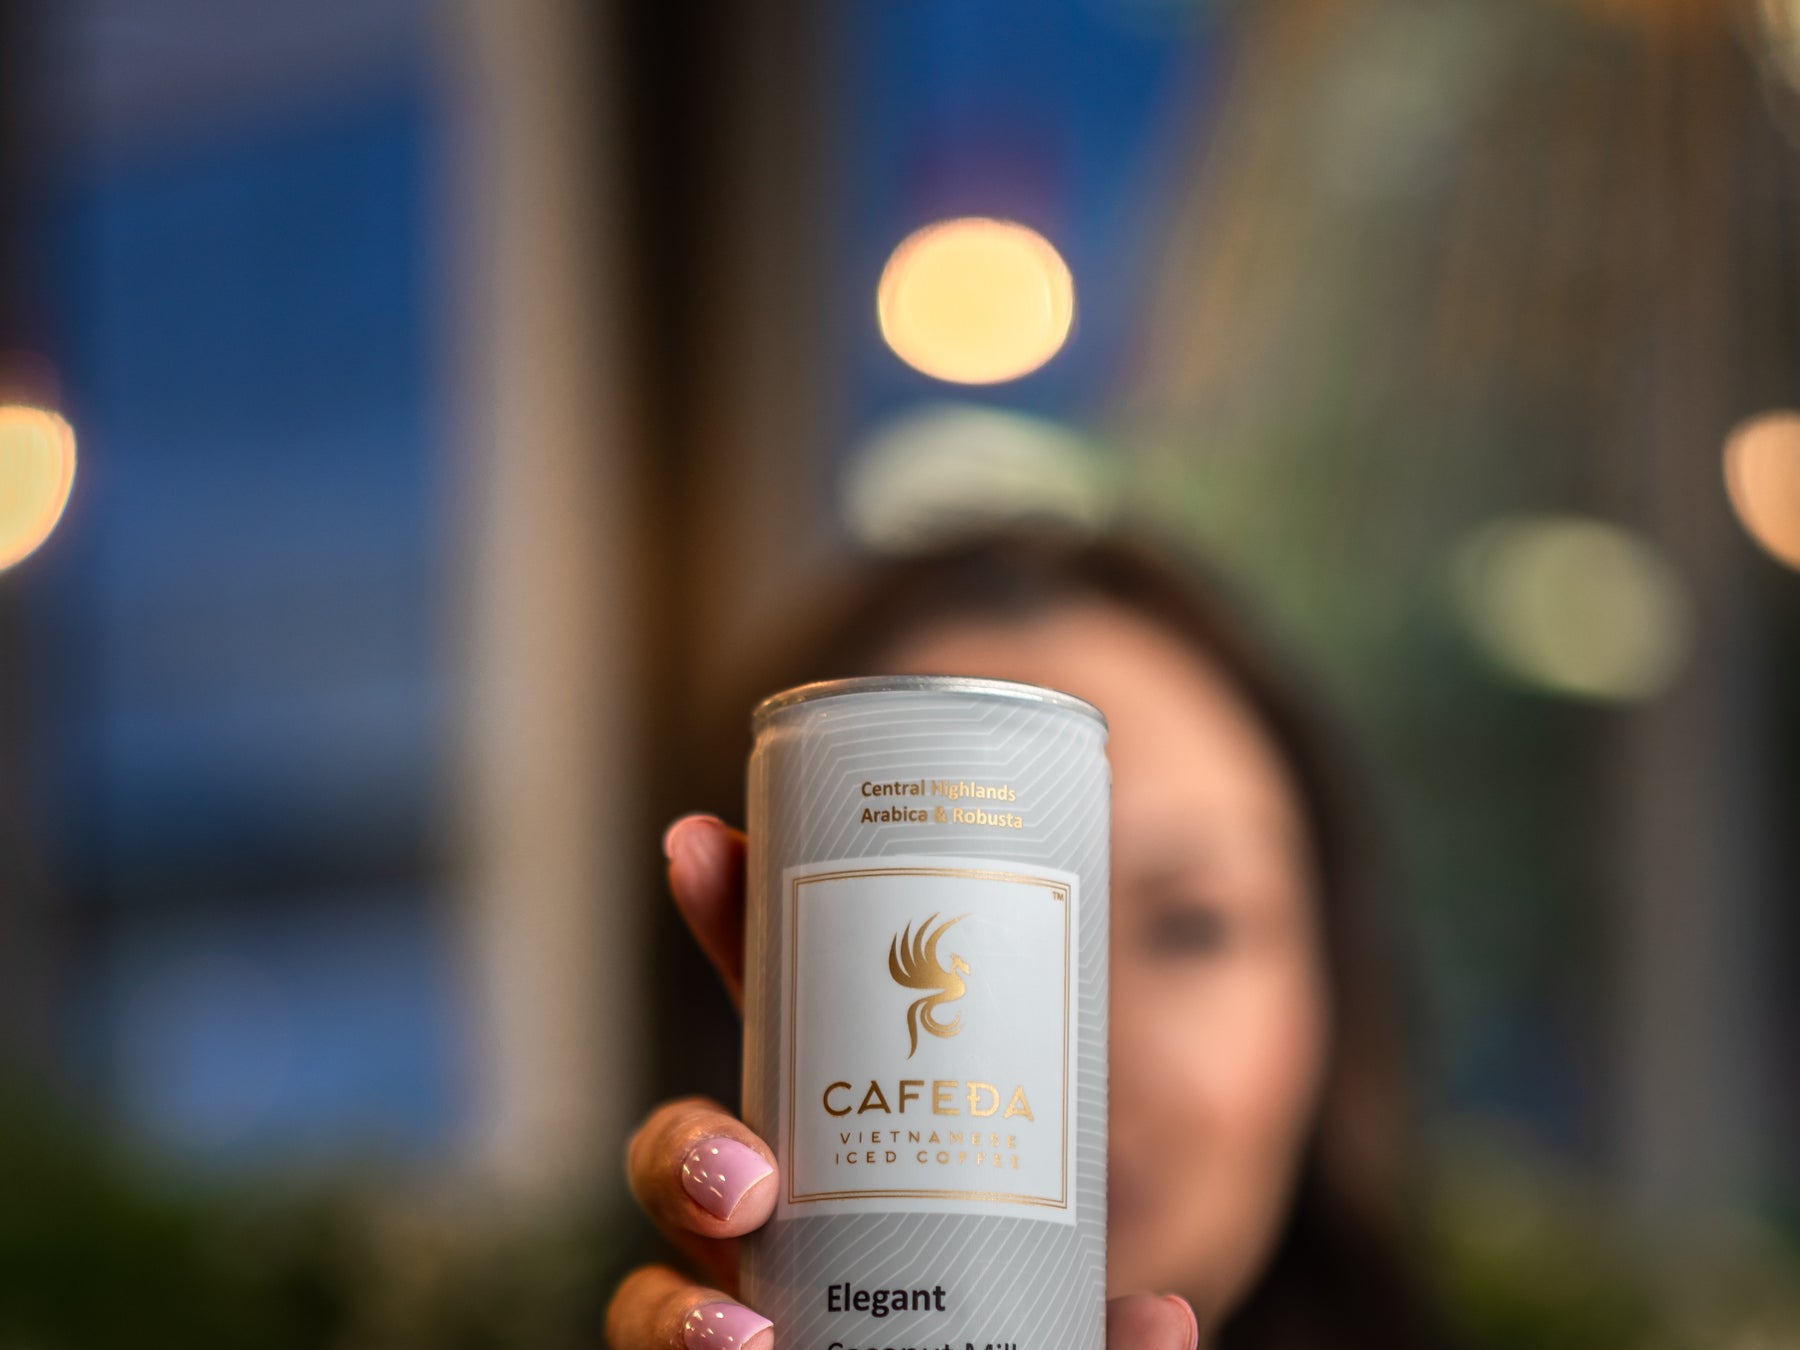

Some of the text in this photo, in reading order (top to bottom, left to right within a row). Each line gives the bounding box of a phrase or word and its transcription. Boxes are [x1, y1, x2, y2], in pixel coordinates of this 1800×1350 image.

[862, 780, 1016, 802] Central Highlands
[861, 806, 1023, 829] Arabica & Robusta
[840, 1131, 1019, 1148] VIETNAMESE
[836, 1151, 1020, 1170] ICED COFFEE
[828, 1282, 946, 1318] Elegant
